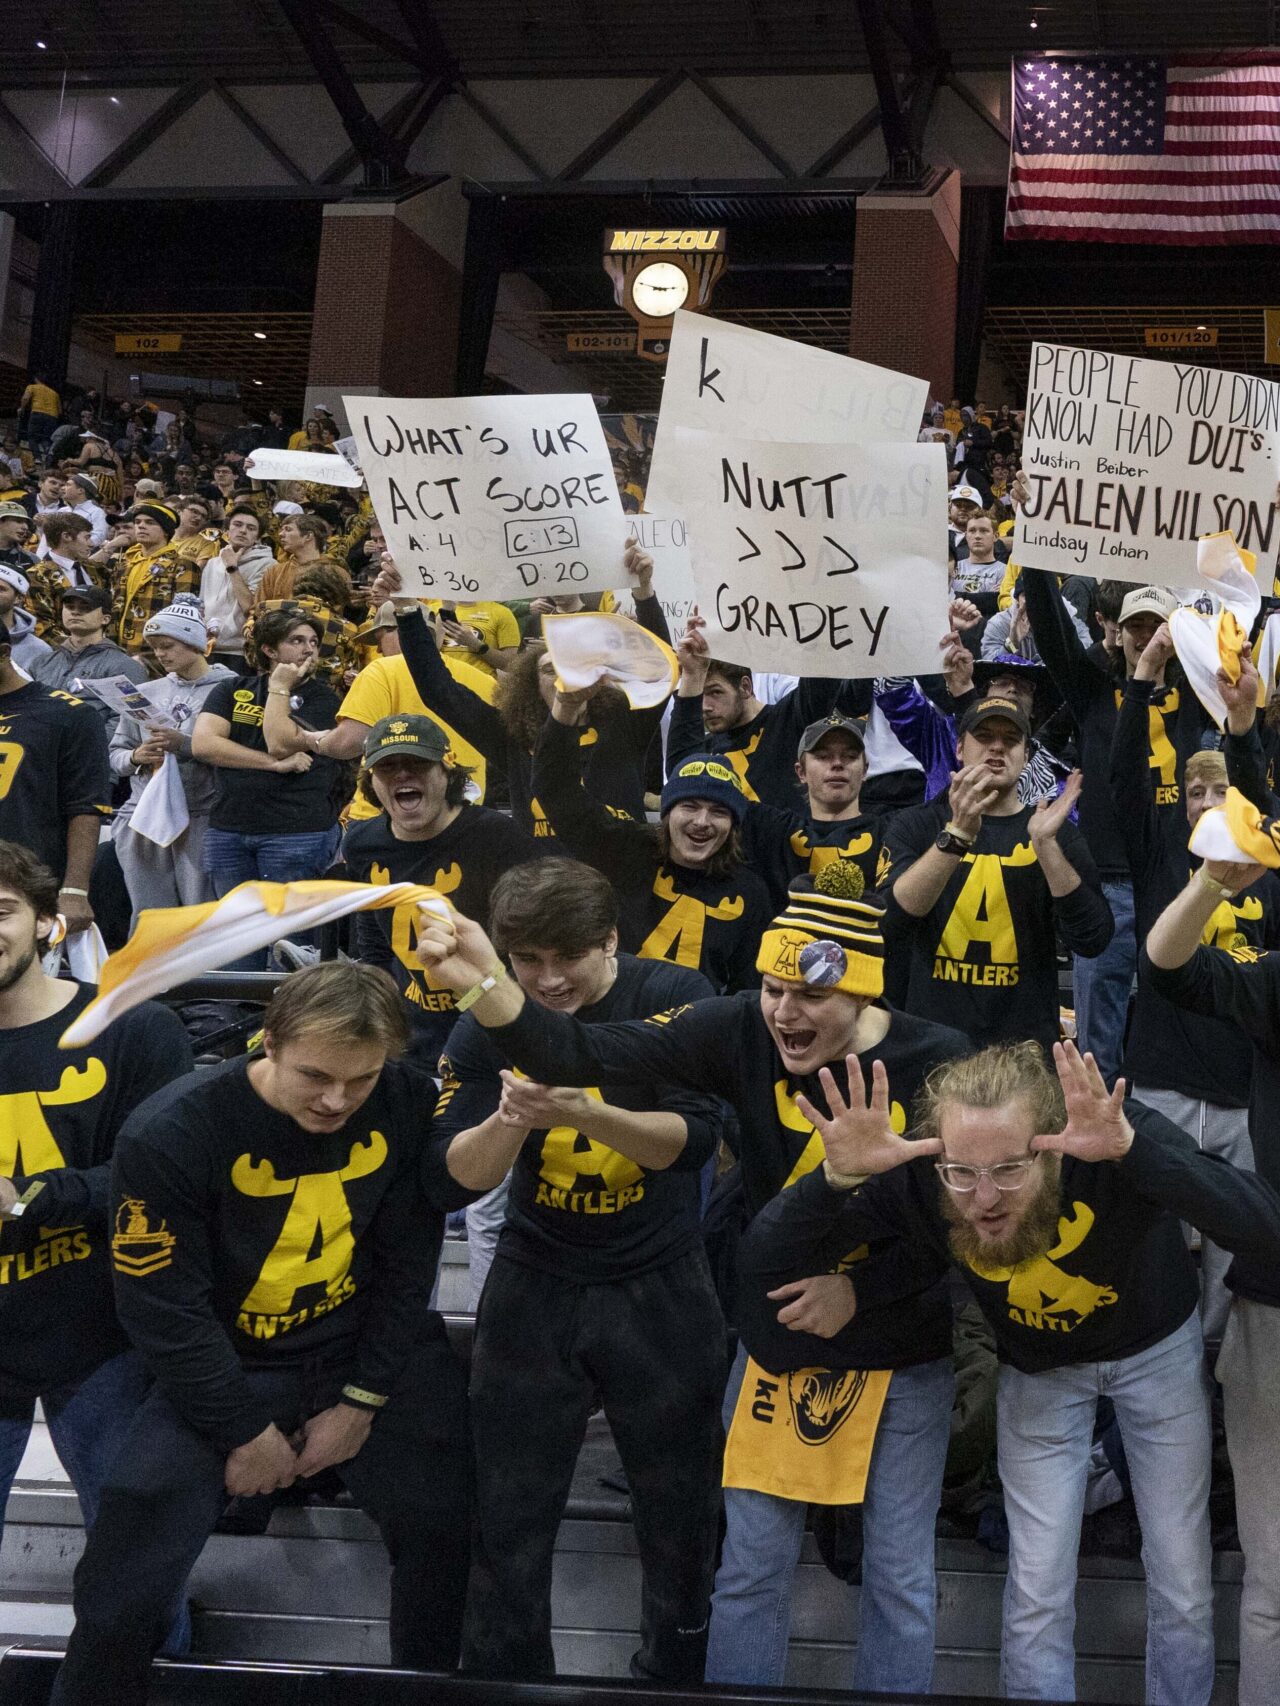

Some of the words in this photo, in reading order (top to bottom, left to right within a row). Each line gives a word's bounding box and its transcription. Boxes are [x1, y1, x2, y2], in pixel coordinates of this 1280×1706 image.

[609, 230, 720, 252] MIZZOU
[134, 338, 159, 350] 102
[573, 335, 630, 350] 102-101
[1151, 331, 1212, 343] 101/120
[1033, 346, 1144, 410] PEOPLE
[1170, 362, 1226, 420] YOU
[364, 415, 509, 457] WHAT'S
[532, 422, 588, 456] UR
[1026, 388, 1100, 446] KNOW
[1113, 406, 1174, 462] HAD
[1029, 444, 1082, 472] Justin
[1095, 456, 1150, 482] Beiber
[388, 477, 460, 524] ACT
[486, 474, 609, 513] SCORE
[1020, 474, 1143, 540] JALEN
[1153, 492, 1276, 554] WILSON
[439, 533, 456, 556] 4
[545, 525, 574, 551] 13
[626, 520, 666, 548] ALE
[1022, 524, 1088, 564] Lindsay
[1099, 534, 1150, 562] Lohan
[444, 571, 479, 592] 36
[555, 561, 588, 582] 20
[717, 583, 889, 656] GRADEY
[381, 734, 419, 746] MISSOURI
[933, 960, 1019, 987] ANTLERS
[535, 1182, 645, 1214] ANTLERS
[0, 1231, 92, 1286] TLERS
[752, 1378, 779, 1424] KU
